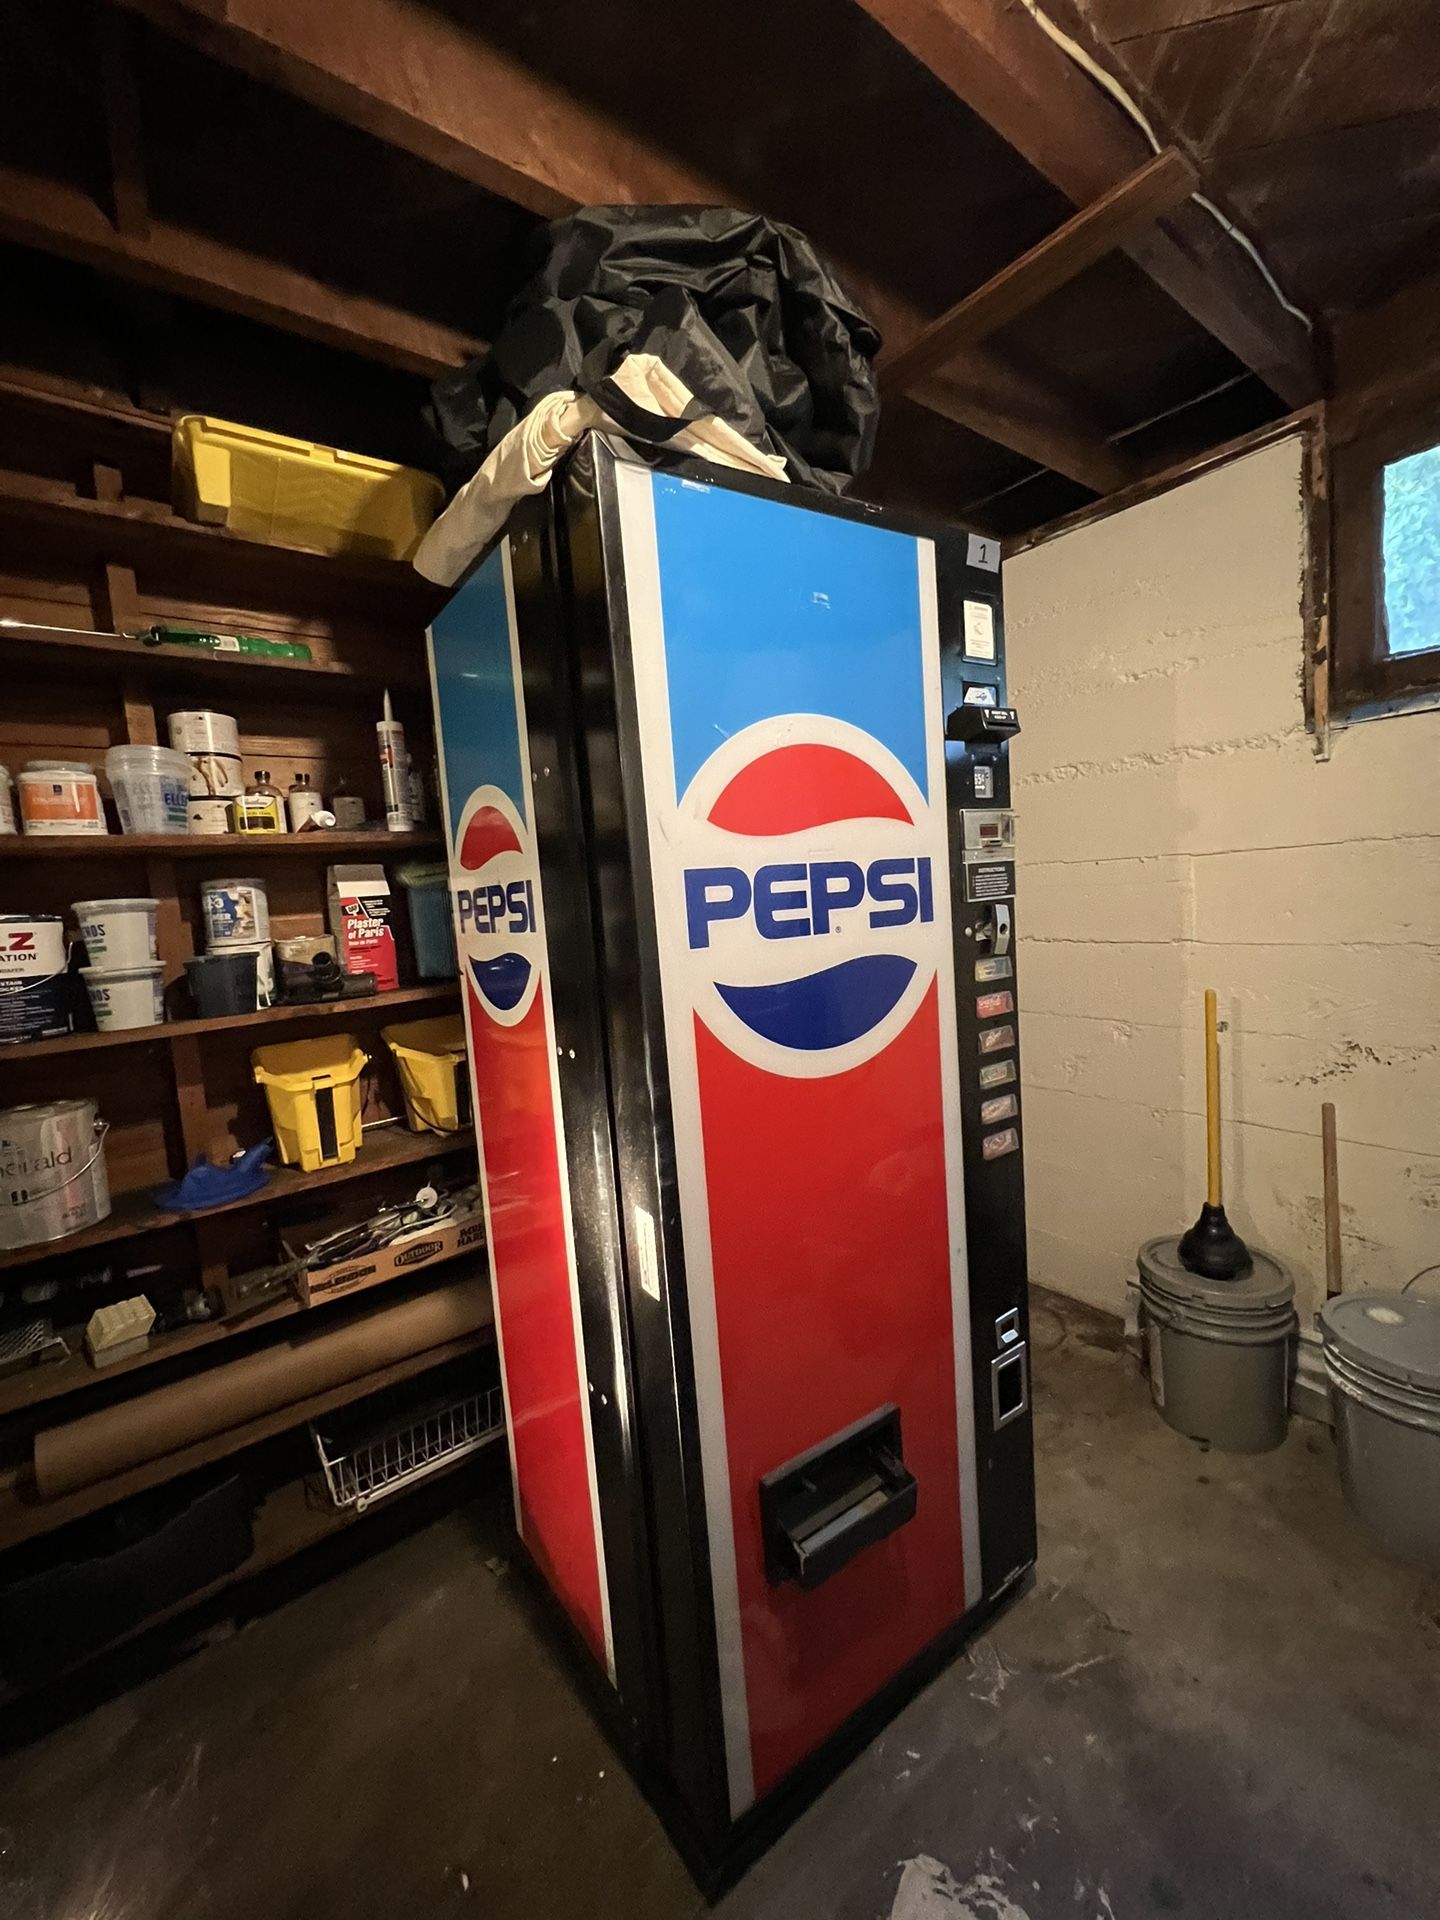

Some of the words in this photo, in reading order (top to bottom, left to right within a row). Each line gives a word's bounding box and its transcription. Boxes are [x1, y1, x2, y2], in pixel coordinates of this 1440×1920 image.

[978, 543, 988, 564] 1
[457, 880, 537, 934] PEPSI
[683, 856, 934, 950] PEPSI
[347, 918, 383, 929] Plaster
[348, 931, 356, 940] of
[358, 928, 384, 938] Paris
